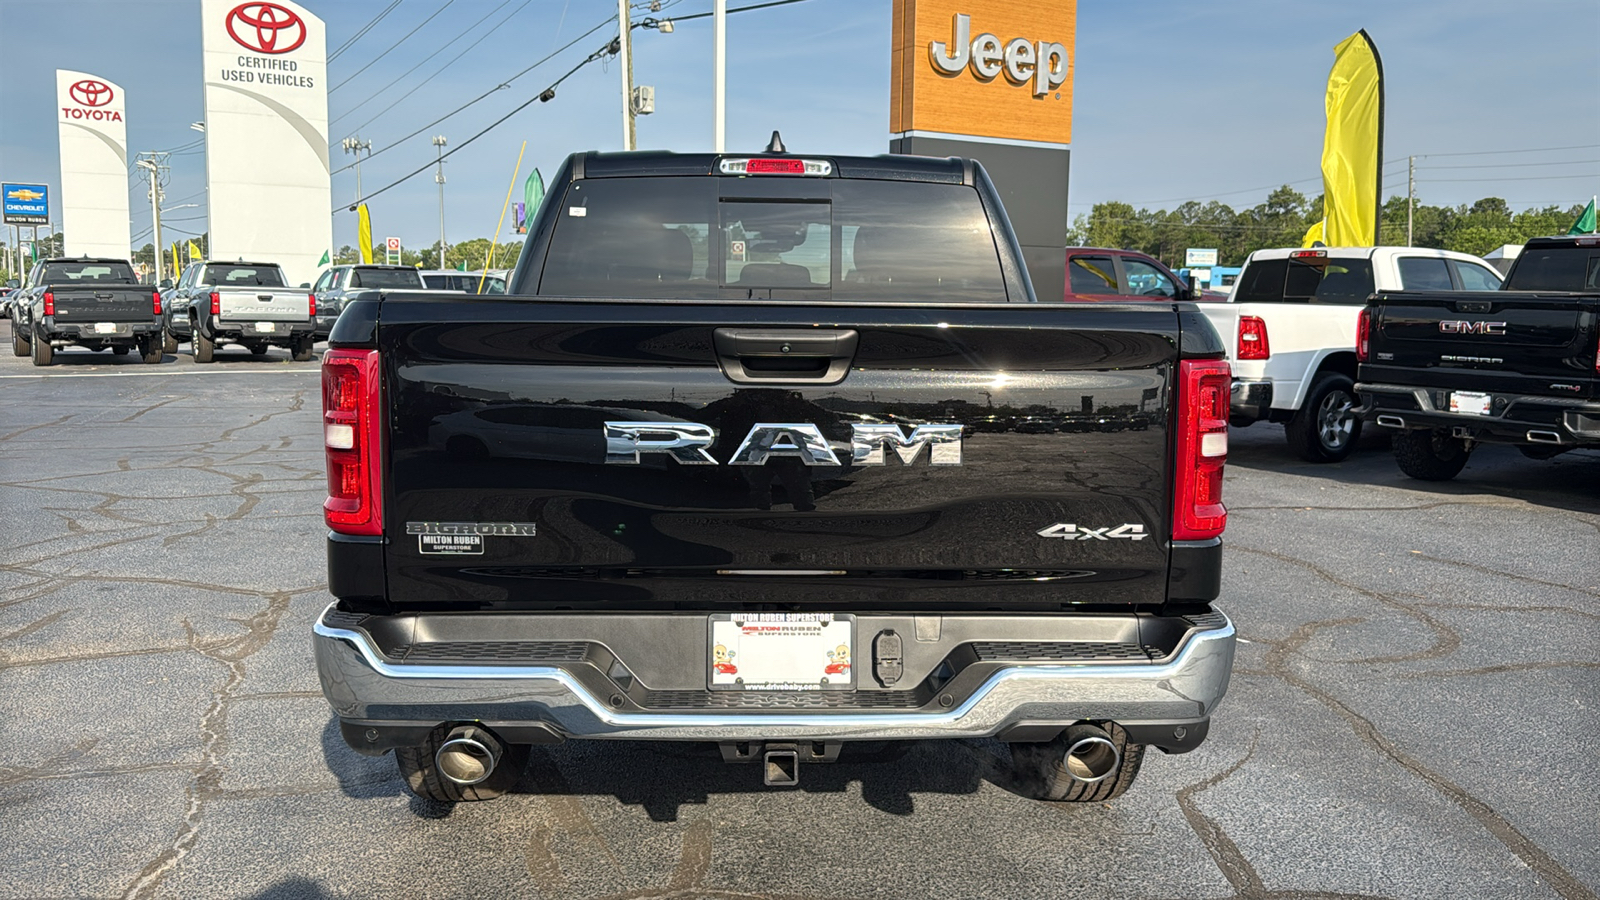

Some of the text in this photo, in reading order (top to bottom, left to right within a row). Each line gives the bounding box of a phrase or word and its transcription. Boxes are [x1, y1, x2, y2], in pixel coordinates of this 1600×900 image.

[929, 12, 1068, 97] Jeep
[237, 55, 298, 72] CERTIFIED
[221, 69, 314, 88] USED VEHICLES
[62, 107, 123, 122] TOYOTA
[6, 204, 45, 212] CHEVROLET
[1439, 320, 1507, 335] GMC
[1441, 355, 1503, 364] SIERRA
[604, 421, 964, 467] RAM
[423, 535, 480, 545] MILTON RUBEN
[730, 613, 759, 622] MILTON
[759, 613, 785, 622] RUBEN
[744, 683, 821, 691] www.drivebaby.com
